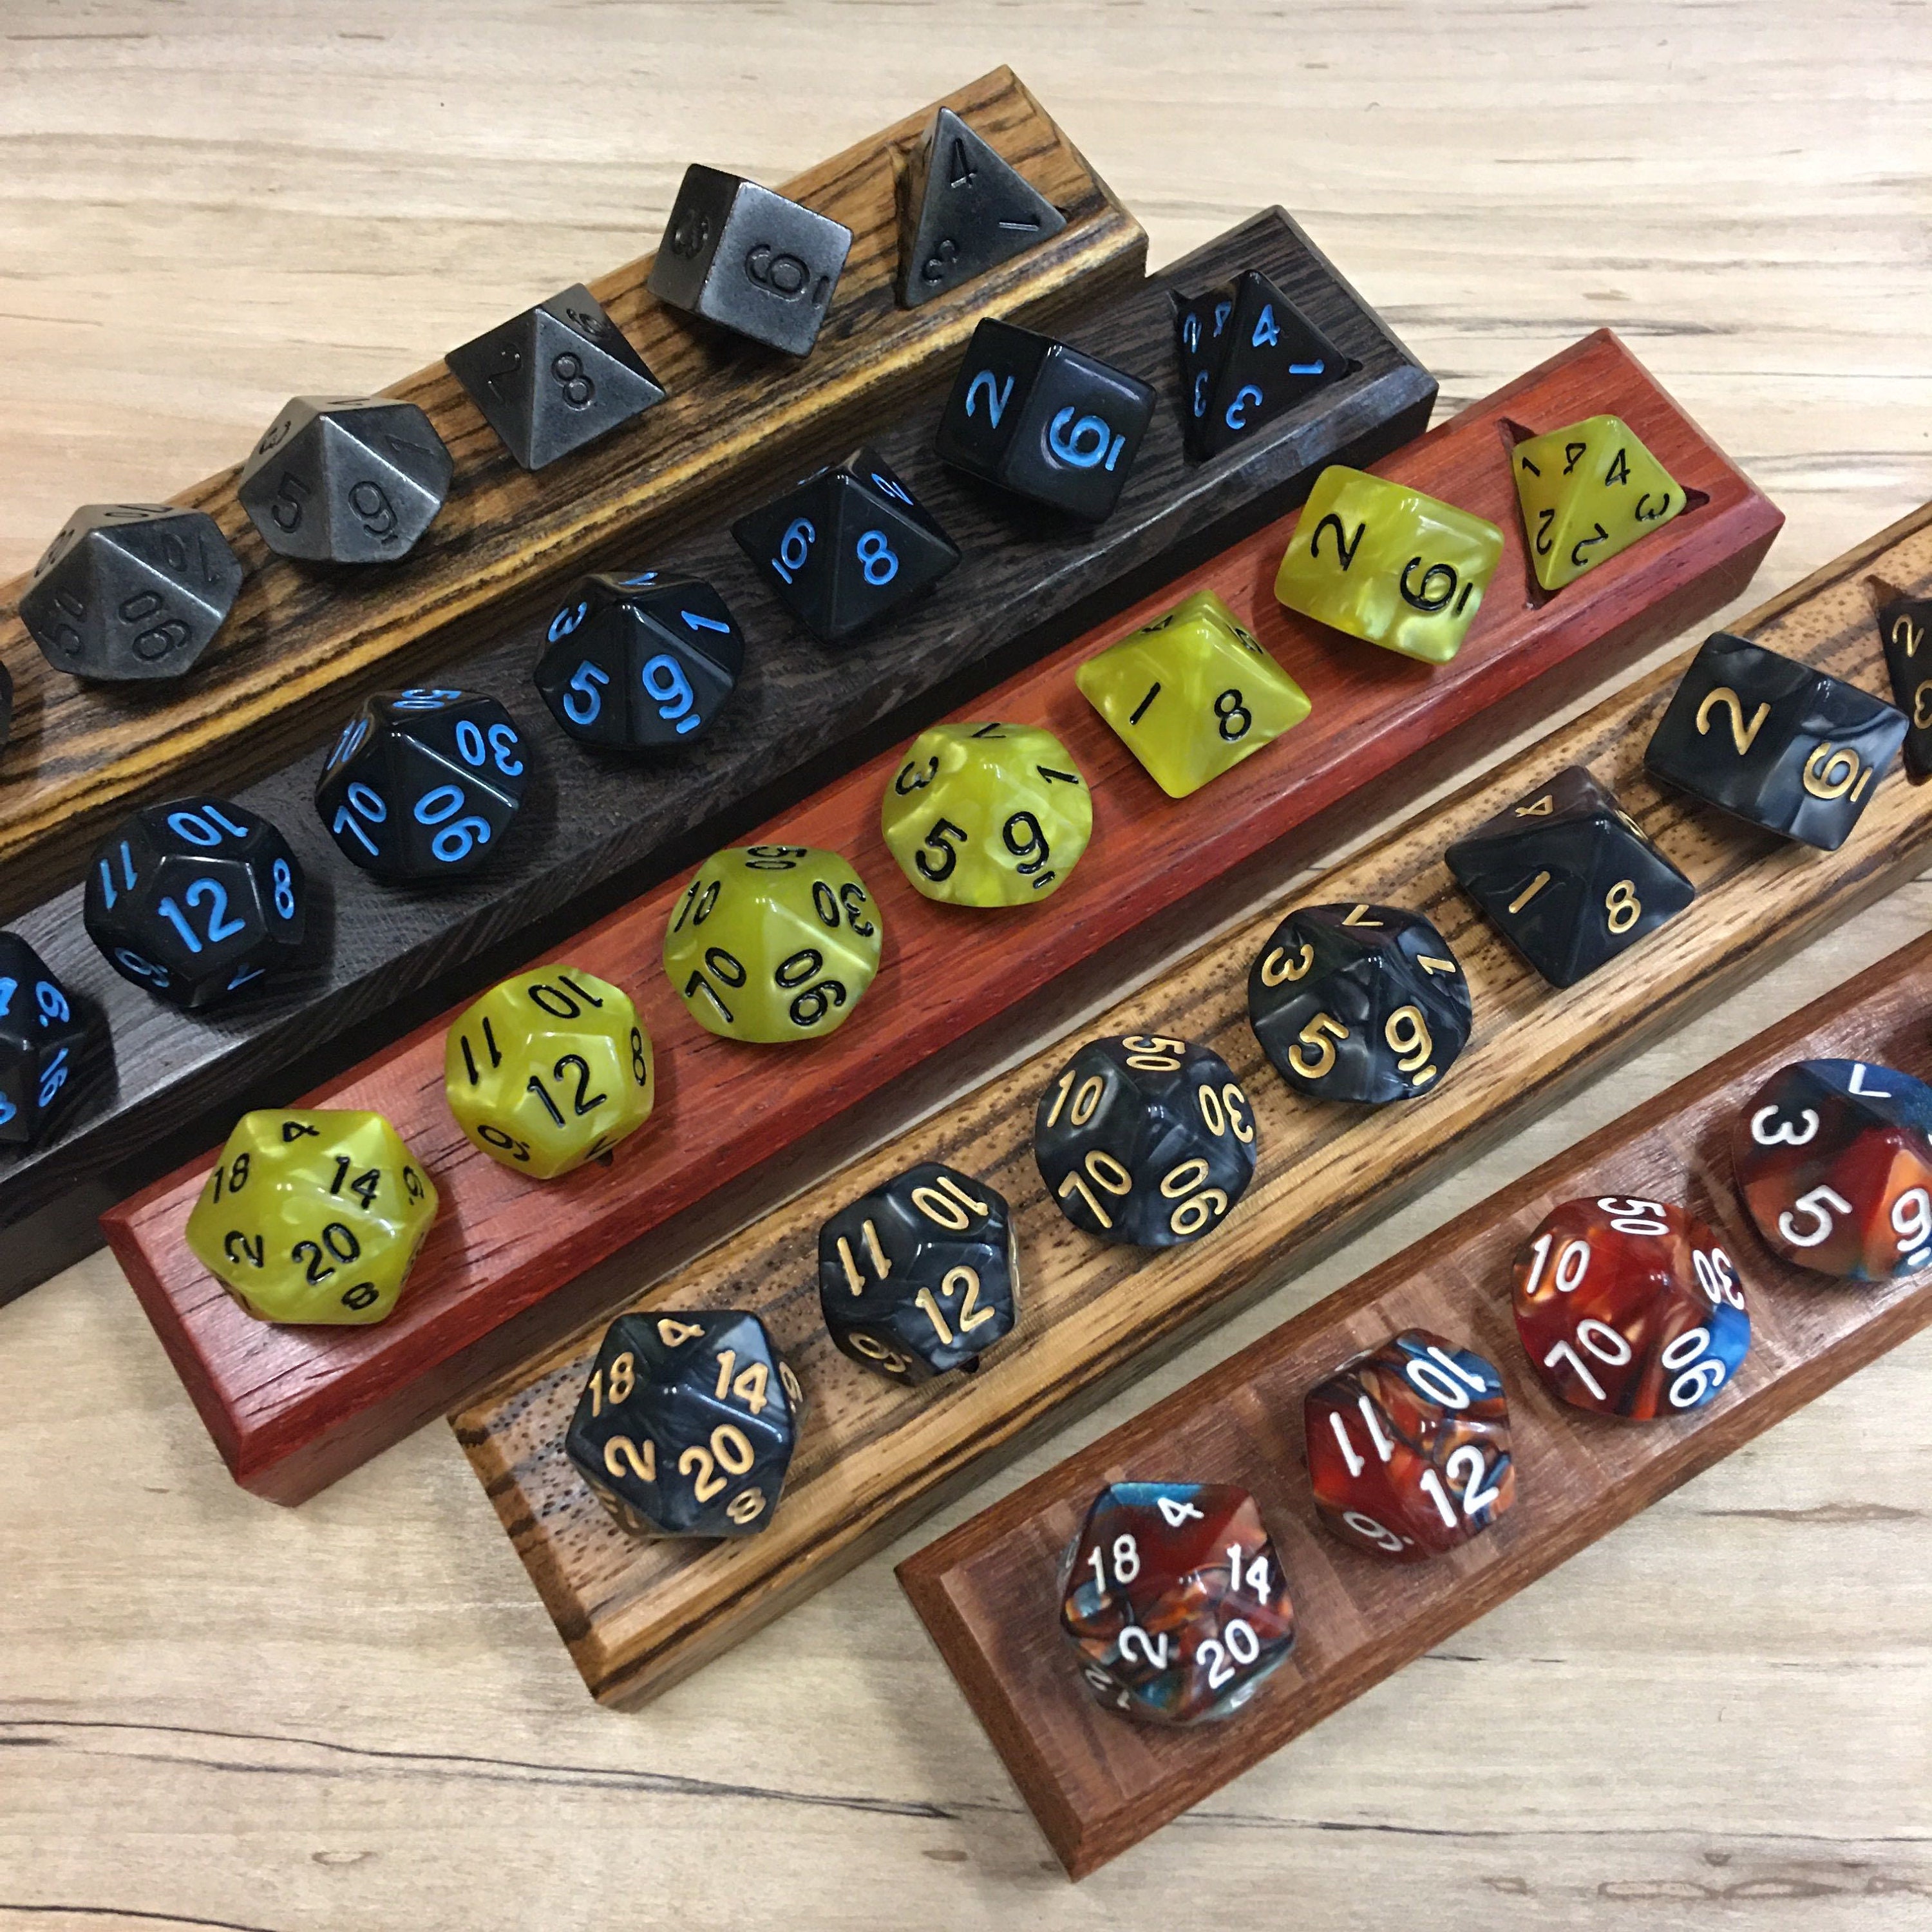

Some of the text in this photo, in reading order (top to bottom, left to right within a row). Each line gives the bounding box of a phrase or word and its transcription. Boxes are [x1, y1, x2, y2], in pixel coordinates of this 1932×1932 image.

[949, 137, 978, 189] 4
[998, 216, 1041, 232] 1
[744, 243, 829, 309] 6
[921, 238, 958, 287] 3
[1253, 304, 1281, 347] 4
[551, 352, 595, 412] 8
[1289, 359, 1325, 374] 1
[967, 370, 1014, 429] 2
[1226, 384, 1263, 430] 3
[1048, 406, 1126, 471] 6
[1522, 456, 1541, 477] 1
[1563, 442, 1587, 475] 4
[1604, 448, 1631, 487] 4
[271, 471, 312, 534] 5
[348, 480, 398, 545] 9
[1536, 508, 1555, 555] 2
[1634, 493, 1670, 522] 3
[772, 517, 816, 585] 6
[857, 530, 900, 585] 8
[1311, 513, 1366, 571] 2
[1571, 523, 1609, 566] 2
[1400, 556, 1473, 616] 6
[549, 601, 587, 642] 3
[1891, 613, 1925, 658] 2
[392, 689, 462, 709] 50
[564, 660, 610, 725] 5
[642, 654, 701, 734] 9
[1129, 681, 1161, 725] 1
[1214, 688, 1252, 741] 8
[1696, 687, 1772, 756] 2
[456, 720, 524, 776] 30
[895, 756, 940, 795] 3
[1803, 742, 1873, 802] 6
[167, 805, 249, 846] 10
[333, 782, 387, 857] 70
[414, 784, 491, 862] 90
[1515, 795, 1553, 818] 4
[99, 840, 138, 911] 11
[745, 846, 808, 869] 50
[915, 817, 968, 882] 5
[1002, 811, 1056, 889] 9
[158, 877, 246, 952] 12
[273, 857, 294, 920] 8
[674, 880, 721, 933] 10
[812, 881, 875, 938] 30
[1508, 870, 1551, 914] 1
[1605, 880, 1642, 934] 8
[685, 947, 746, 1023] 70
[775, 949, 847, 1027] 90
[1262, 944, 1314, 987] 3
[527, 975, 603, 1019] 10
[460, 1016, 502, 1086] 11
[630, 1027, 647, 1086] 8
[1122, 1036, 1186, 1071] 50
[1289, 1012, 1350, 1079] 5
[1385, 1005, 1437, 1086] 9
[527, 1054, 607, 1129] 12
[1046, 1070, 1103, 1128] 10
[1848, 1063, 1892, 1098] 7
[282, 1121, 319, 1142] 4
[1198, 1083, 1254, 1143] 30
[1751, 1104, 1820, 1146] 3
[213, 1152, 251, 1204] 18
[330, 1156, 381, 1210] 14
[911, 1176, 989, 1229] 10
[1058, 1150, 1132, 1228] 70
[1160, 1158, 1228, 1235] 90
[1597, 1197, 1670, 1236] 50
[1778, 1185, 1853, 1247] 5
[1891, 1188, 1932, 1266] 9
[224, 1230, 264, 1269] 2
[292, 1222, 361, 1285] 20
[837, 1219, 893, 1297] 11
[1526, 1233, 1591, 1294] 10
[1692, 1247, 1745, 1311] 30
[341, 1282, 380, 1311] 8
[914, 1265, 996, 1345] 12
[657, 1318, 706, 1347] 4
[1544, 1319, 1632, 1401] 70
[589, 1352, 636, 1417] 18
[714, 1349, 768, 1415] 14
[1406, 1346, 1487, 1410] 10
[1662, 1327, 1726, 1408] 90
[604, 1435, 656, 1482] 2
[678, 1423, 755, 1502] 20
[1329, 1395, 1395, 1477] 11
[726, 1486, 767, 1525] 8
[1157, 1496, 1205, 1528] 4
[1420, 1444, 1500, 1528] 12
[1088, 1533, 1141, 1594] 18
[1227, 1542, 1271, 1605] 14
[1119, 1625, 1168, 1670] 2
[1196, 1618, 1260, 1689] 20
